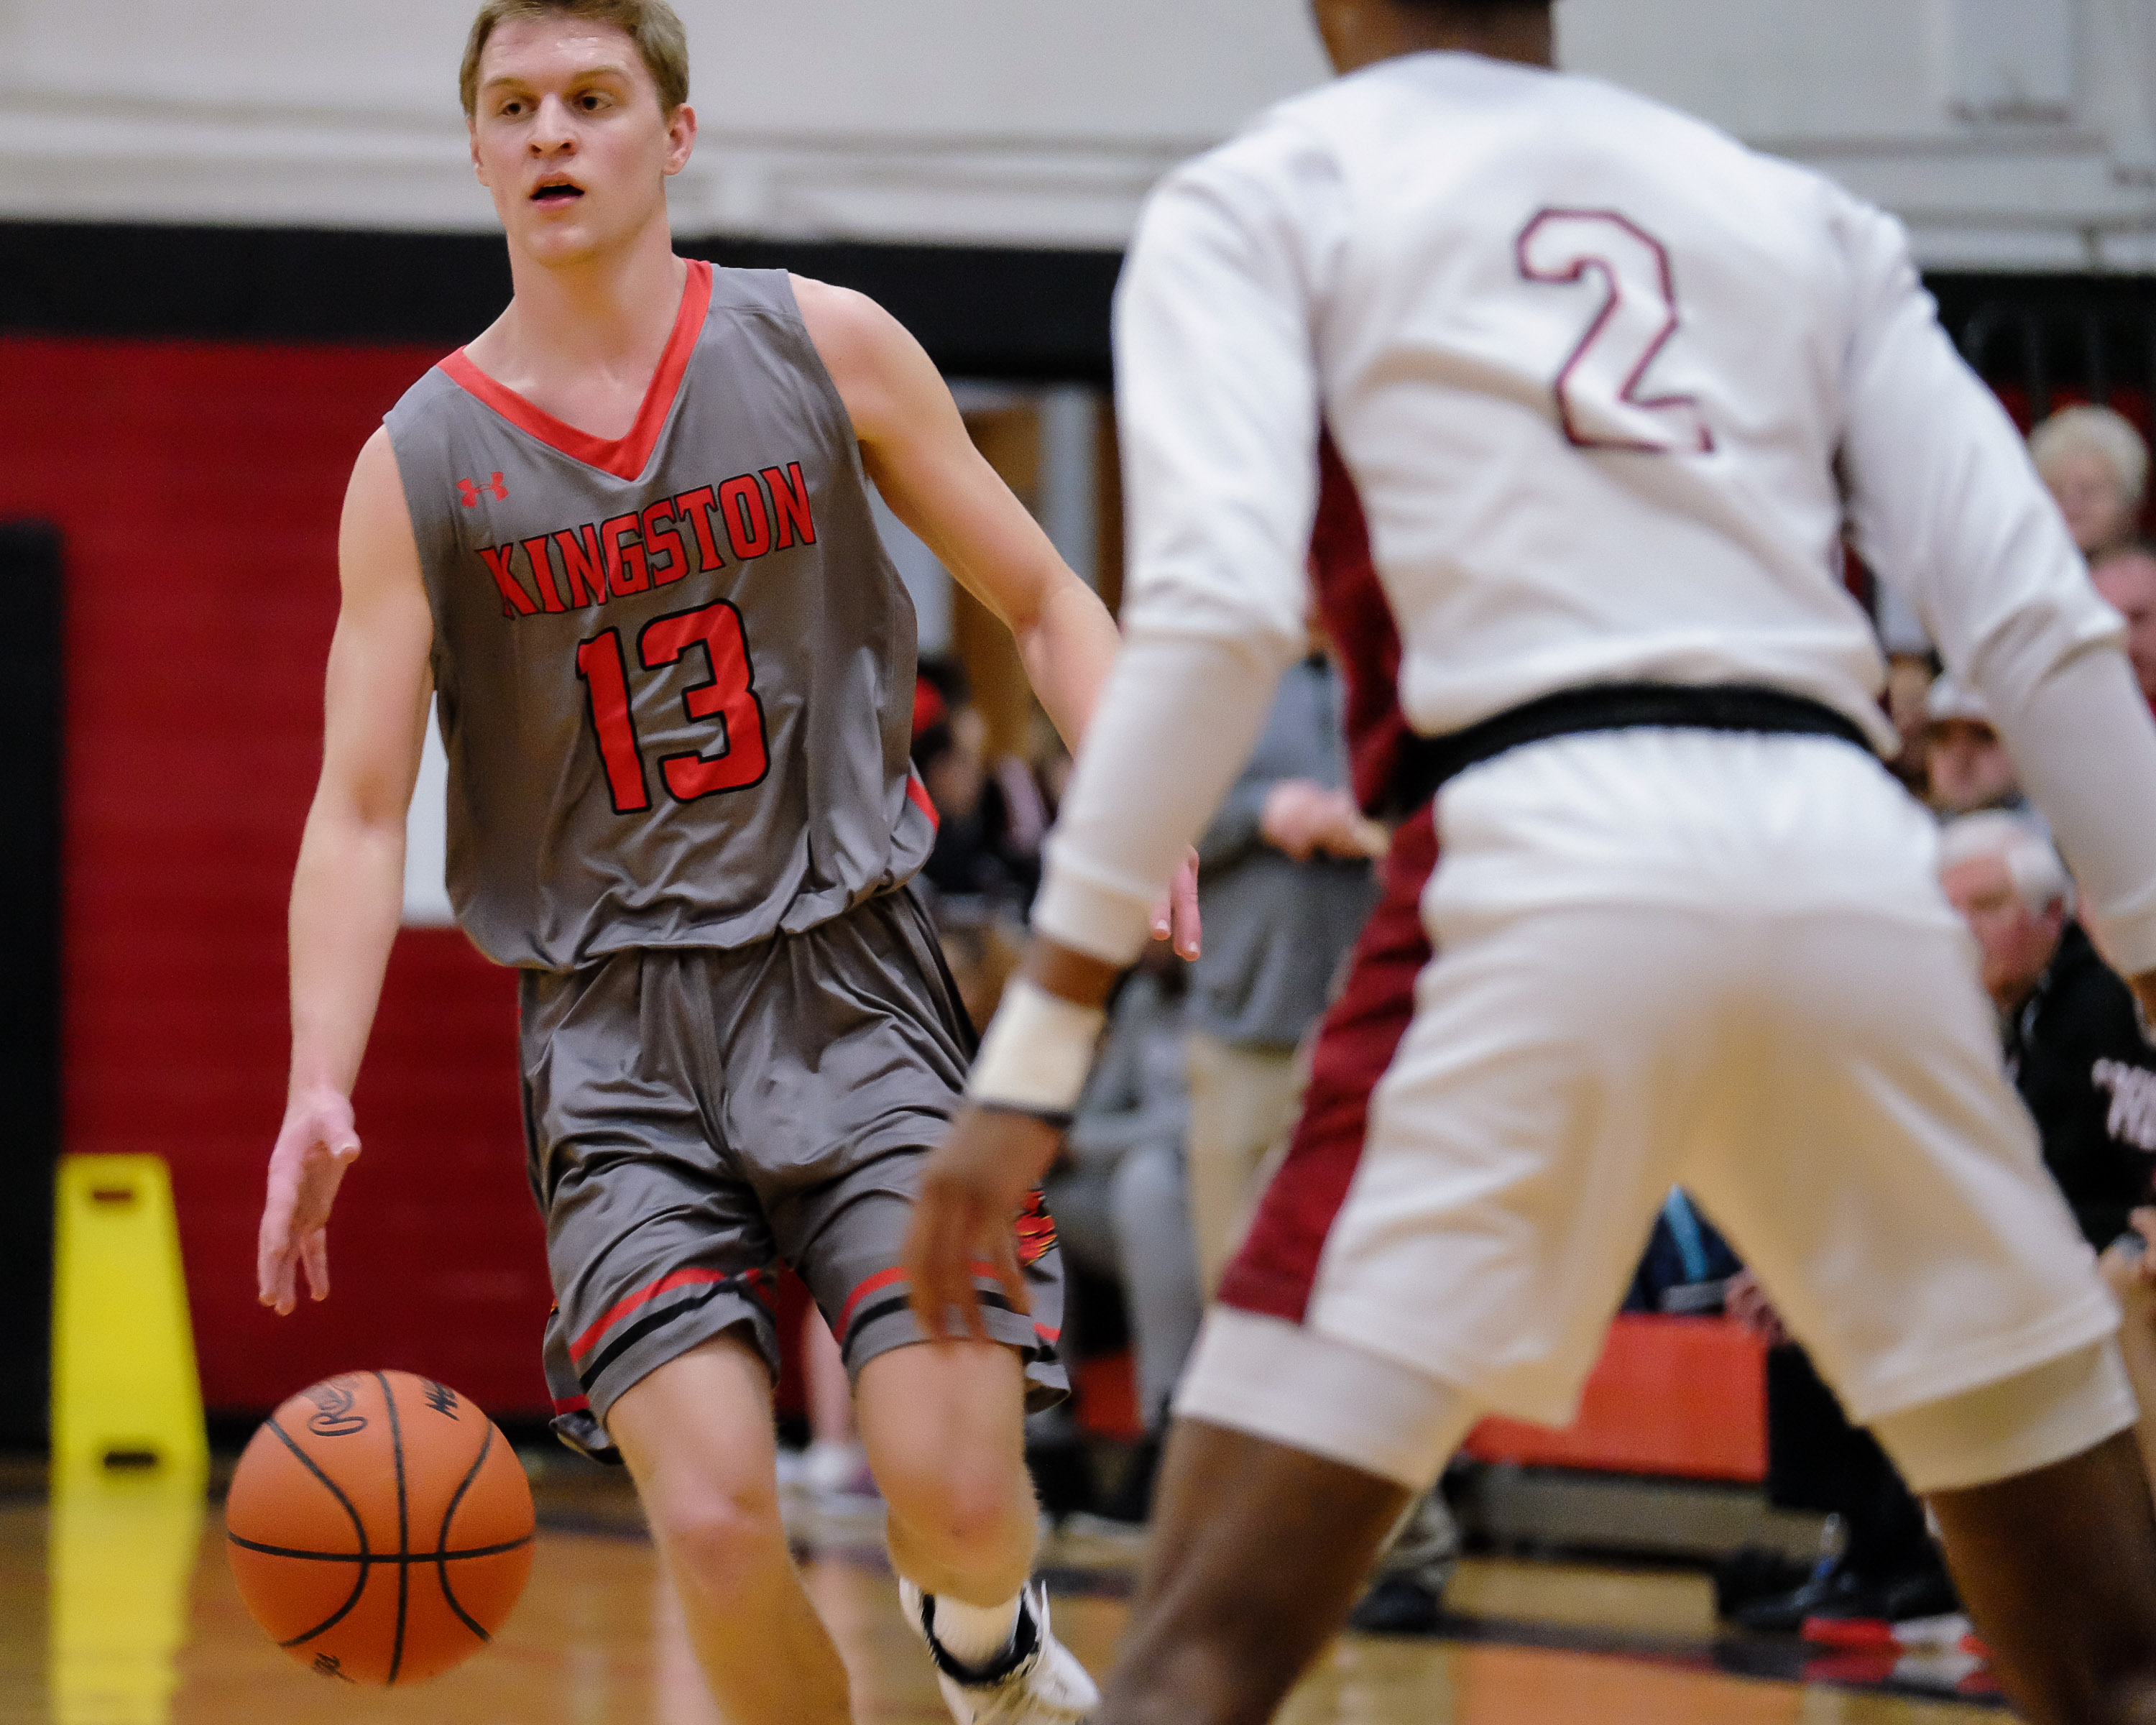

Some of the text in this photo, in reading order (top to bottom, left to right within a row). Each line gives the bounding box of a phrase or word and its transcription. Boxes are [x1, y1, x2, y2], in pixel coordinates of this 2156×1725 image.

[1515, 208, 1715, 453] 2
[474, 461, 816, 620] KINGSTON
[576, 597, 770, 816] 13
